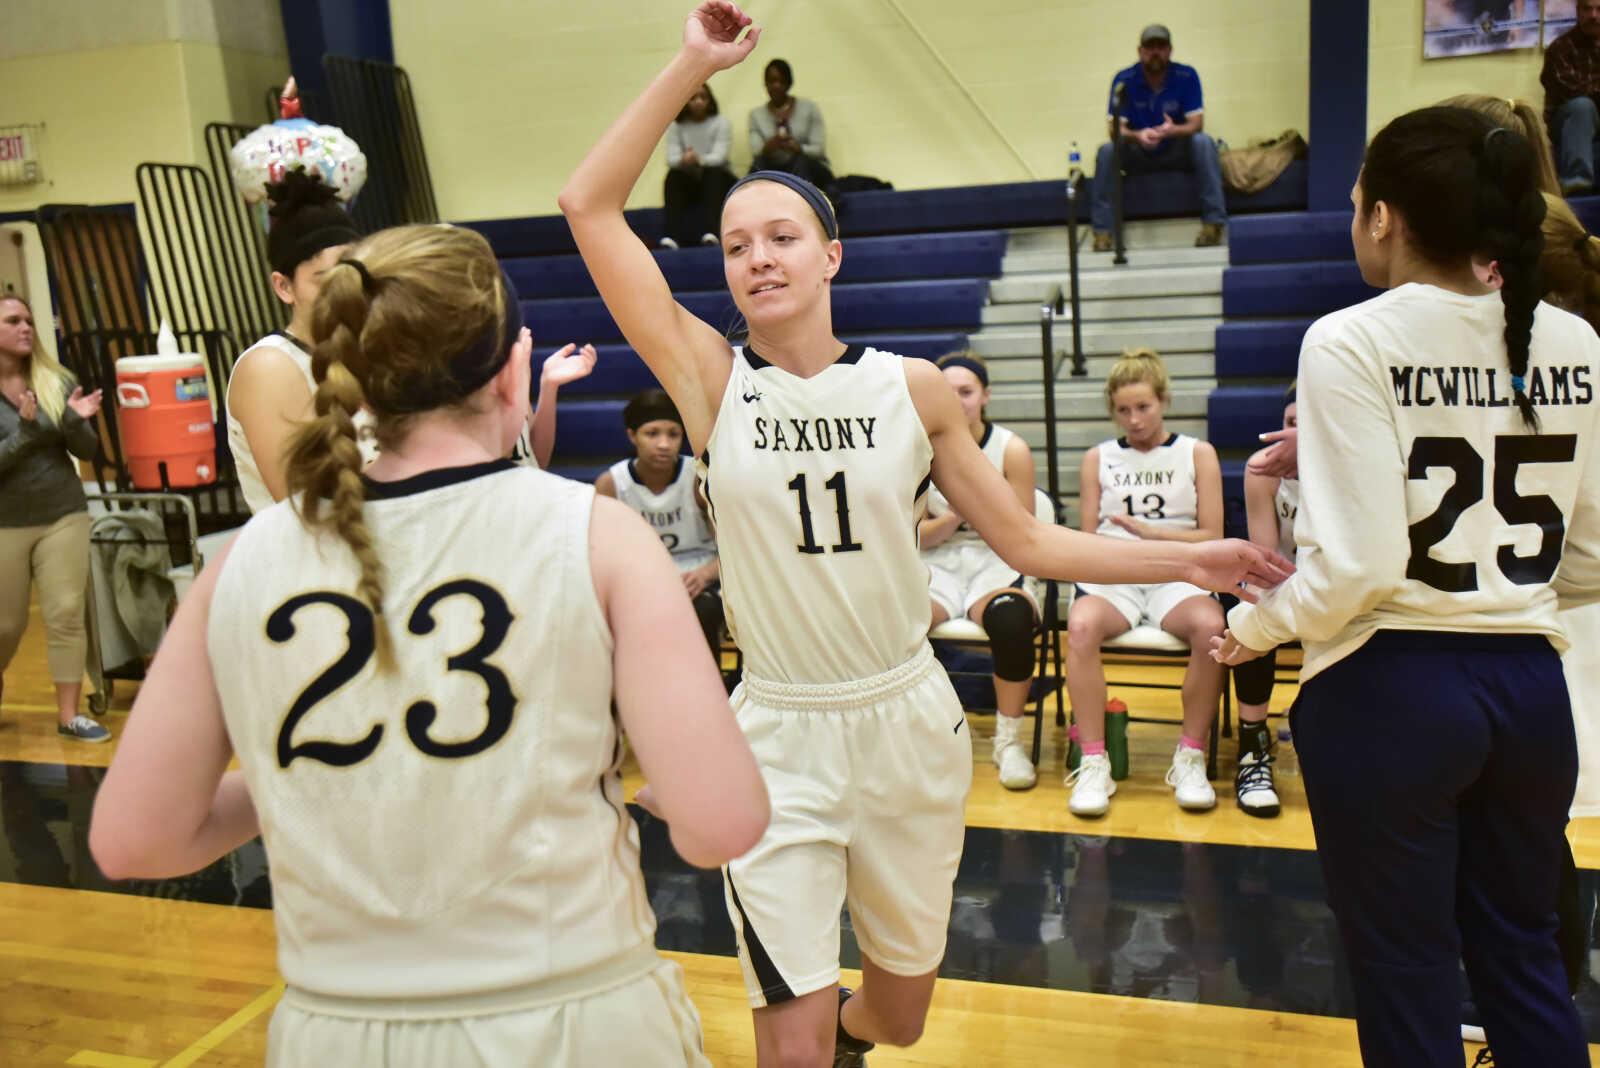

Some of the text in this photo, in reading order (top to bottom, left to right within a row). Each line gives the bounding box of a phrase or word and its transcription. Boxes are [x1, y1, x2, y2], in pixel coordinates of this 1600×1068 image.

[1390, 365, 1593, 408] MCWILLAMS
[754, 416, 876, 452] SAXONY
[1113, 470, 1175, 487] SAXONY
[788, 470, 863, 555] 11
[1122, 493, 1166, 519] 13
[1405, 433, 1578, 593] 25
[266, 578, 519, 769] 23
